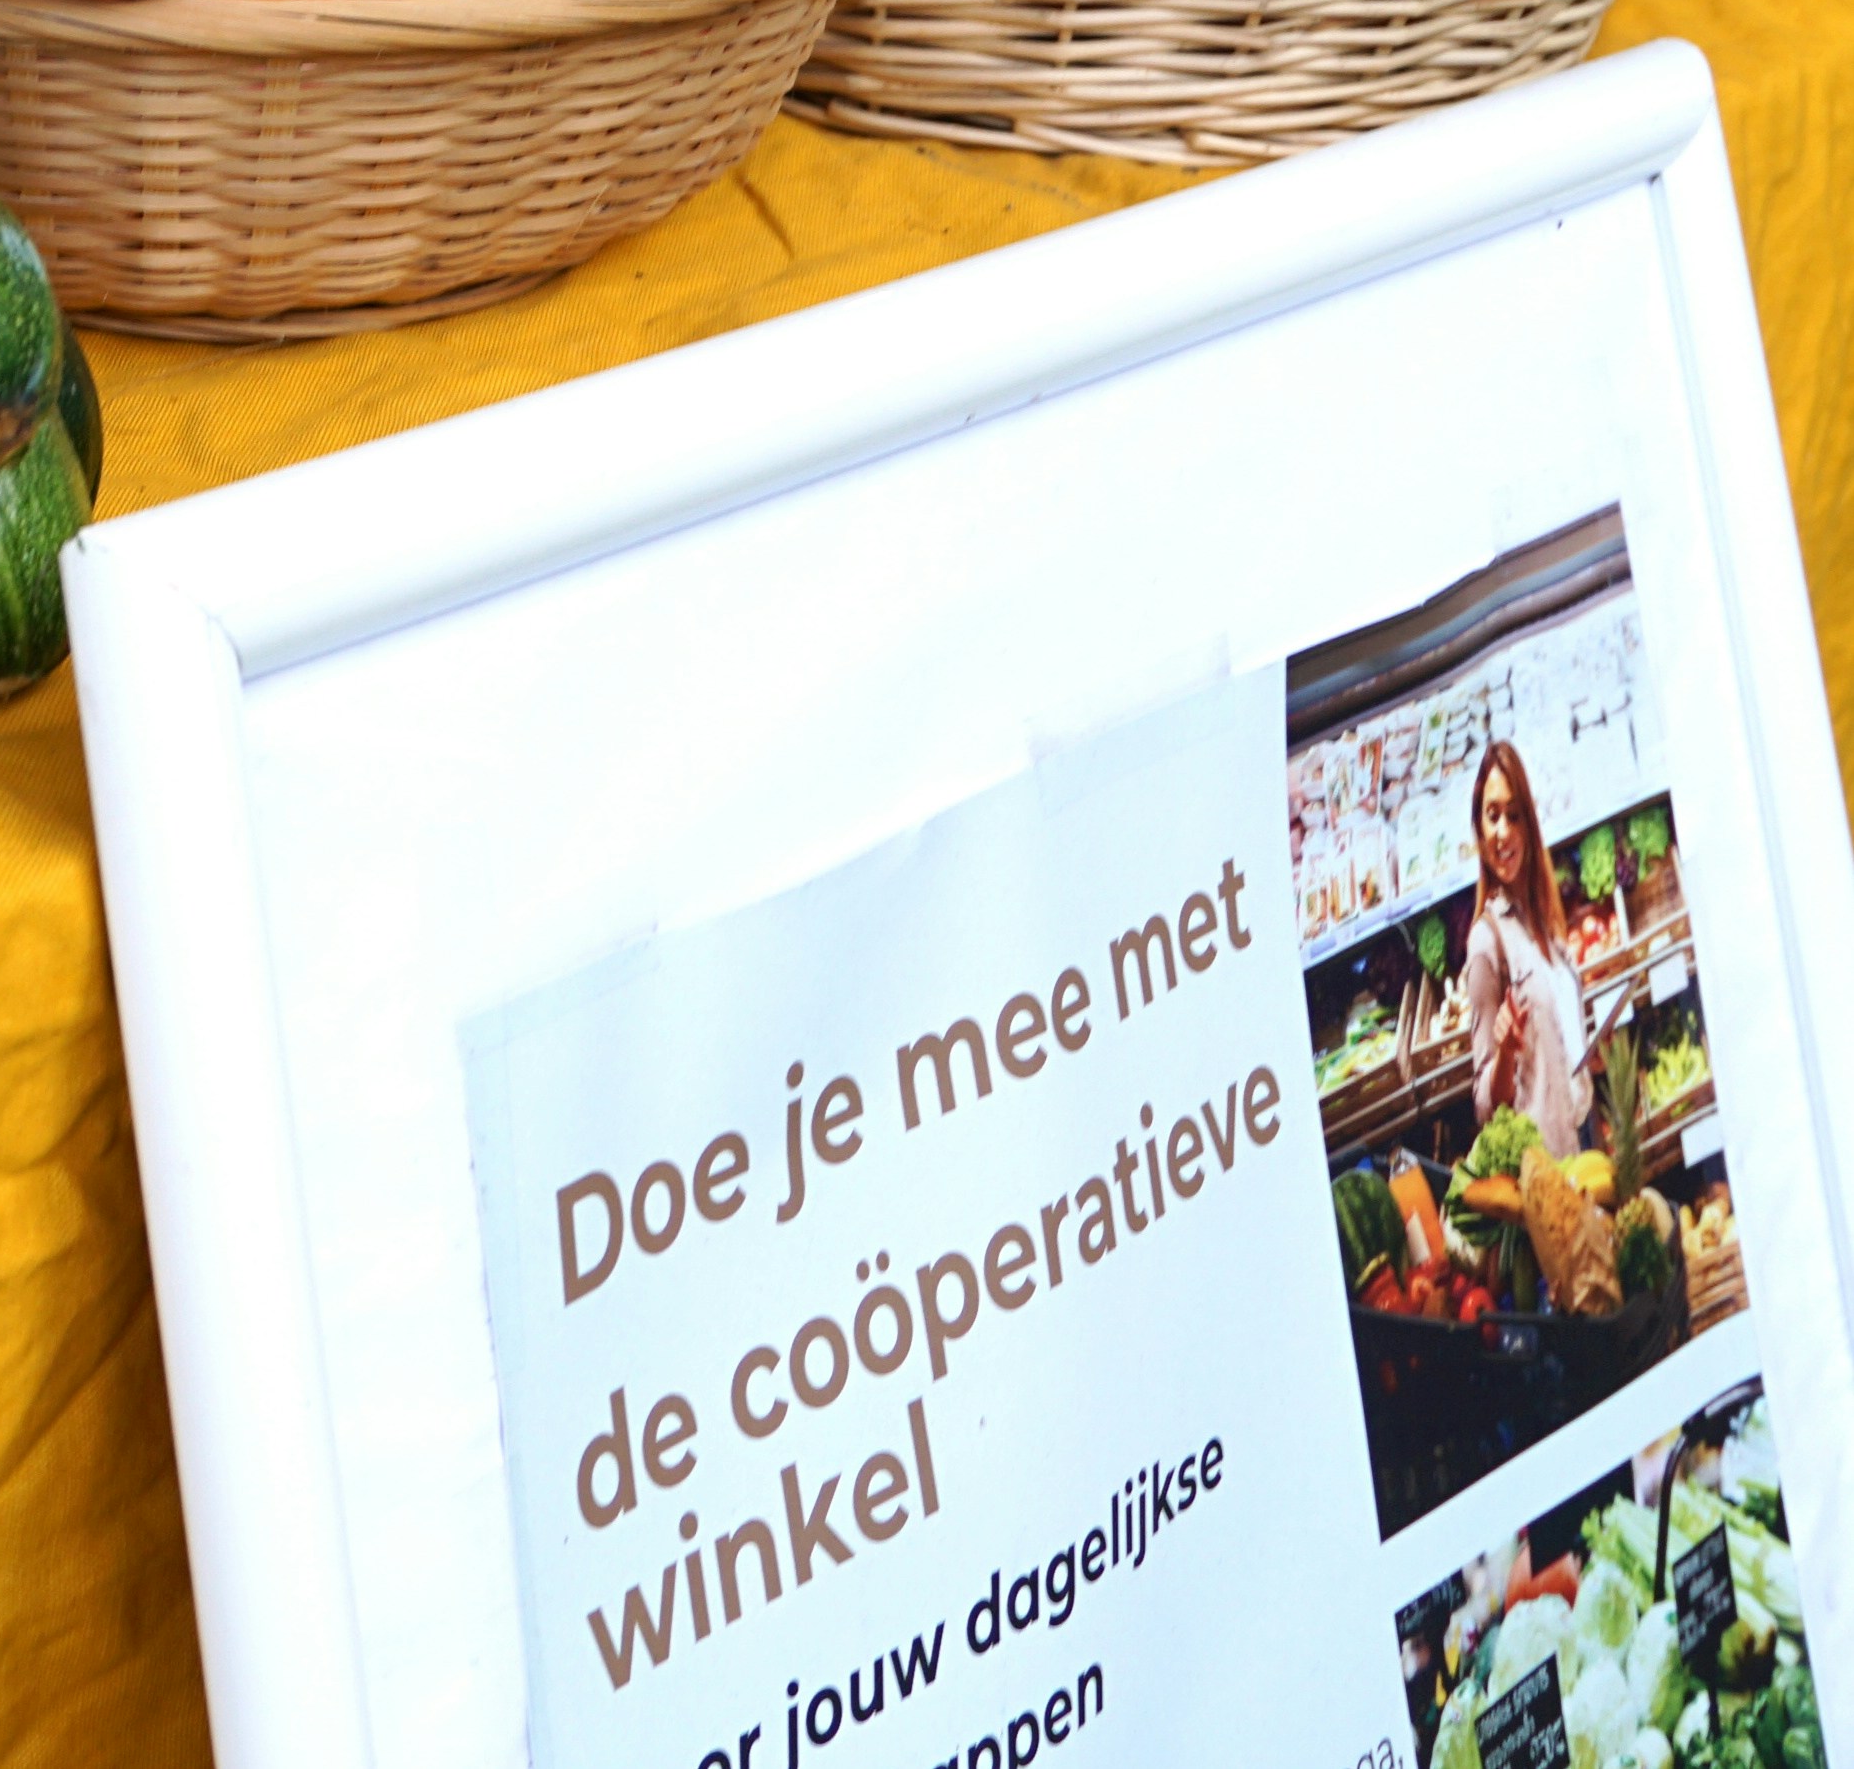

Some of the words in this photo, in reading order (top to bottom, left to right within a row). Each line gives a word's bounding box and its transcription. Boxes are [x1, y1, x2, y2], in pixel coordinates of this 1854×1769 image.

[554, 1127, 751, 1307] Doe
[775, 1058, 864, 1225] je
[895, 966, 1091, 1132] mee
[1110, 858, 1252, 1021] met
[576, 1385, 697, 1529] de
[730, 1063, 1283, 1439] coöperatieve
[586, 1396, 941, 1691] winkel
[787, 1619, 946, 1769] jouw
[965, 1435, 1225, 1655] dagelijkse
